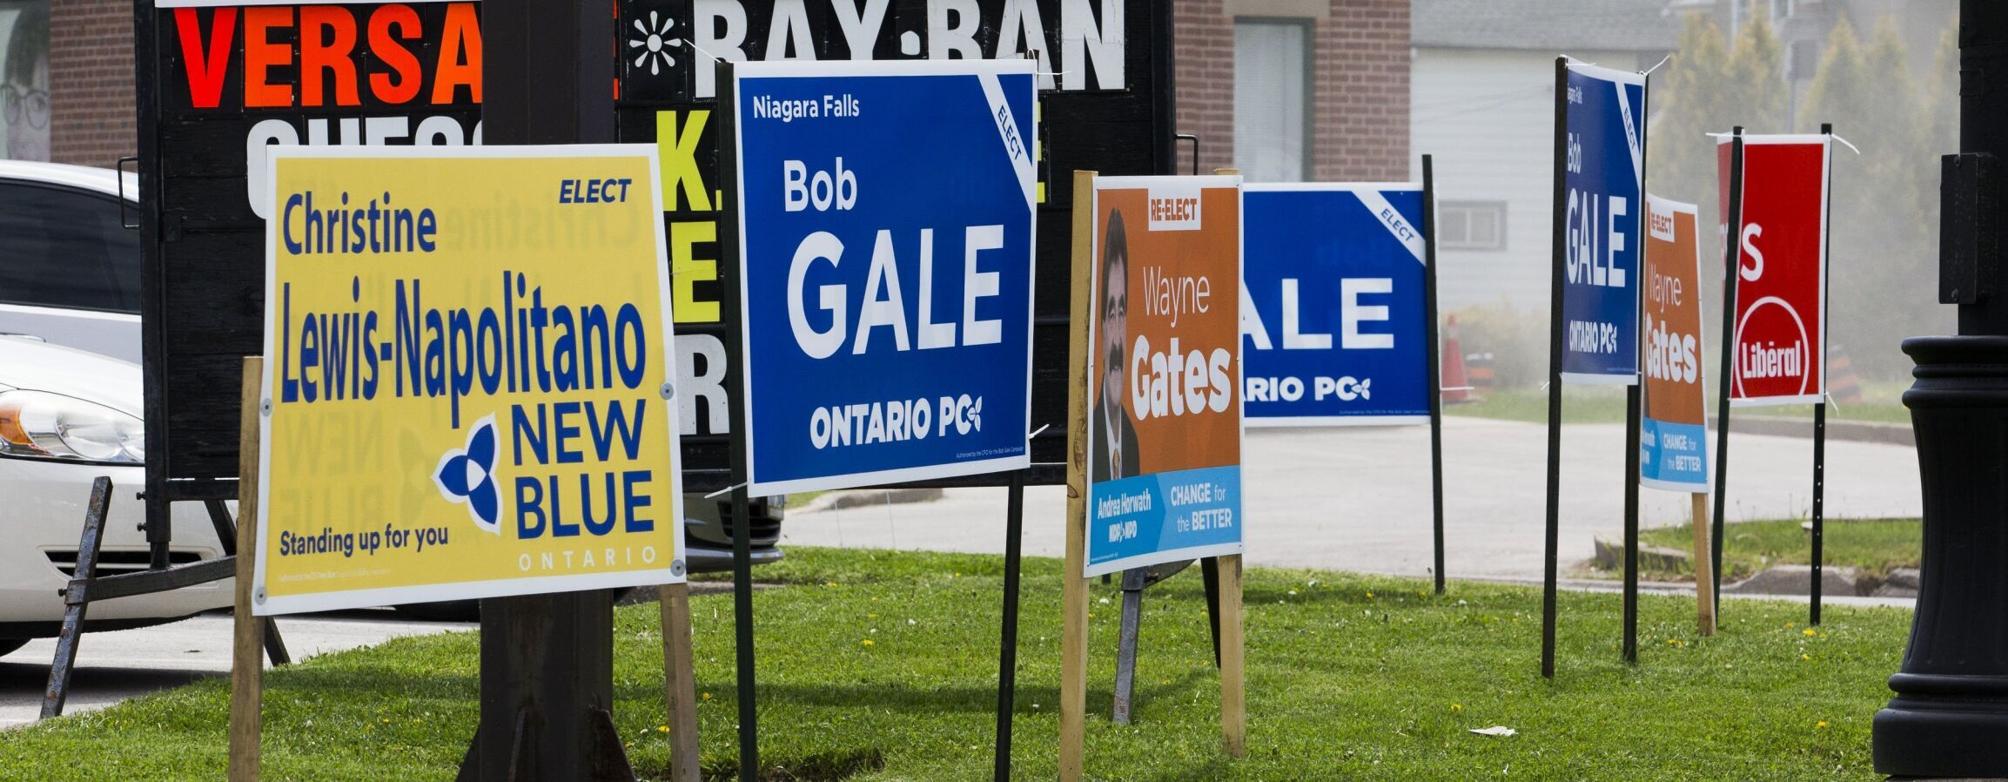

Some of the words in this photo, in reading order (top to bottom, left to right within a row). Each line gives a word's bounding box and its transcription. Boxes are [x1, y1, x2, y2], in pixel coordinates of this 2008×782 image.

[173, 3, 618, 109] VERSA
[753, 95, 819, 123] Niagara
[823, 93, 860, 118] Falls
[998, 104, 1022, 160] ELECT
[1567, 132, 1582, 175] Bob
[559, 178, 632, 204] ELECT
[783, 156, 858, 213] Bob
[1151, 198, 1198, 222] RE-ELECT
[282, 191, 437, 256] Christine
[1380, 207, 1415, 243] ELECT
[1566, 188, 1627, 288] GALE
[787, 224, 1004, 360] GALE
[1142, 265, 1211, 329] Wayne
[1649, 263, 1682, 313] Wayne
[281, 269, 647, 430] Lewis-Napolitano
[1569, 319, 1599, 353] ONTARIO
[1600, 322, 1614, 355] PC
[1644, 311, 1698, 385] Gates
[1131, 334, 1232, 421] Gates
[1314, 376, 1357, 402] PC
[511, 399, 647, 467] NEW
[810, 397, 932, 449] ONTARIO
[938, 393, 974, 438] PC
[515, 469, 655, 540] BLUE
[1170, 483, 1212, 507] CHANGE
[1214, 484, 1226, 502] for
[1177, 516, 1190, 533] the
[1191, 507, 1232, 532] BETTER
[280, 527, 354, 558] Standing
[359, 532, 381, 555] up
[385, 523, 410, 548] for
[415, 527, 448, 553] you
[518, 545, 656, 572] ONTARIO
